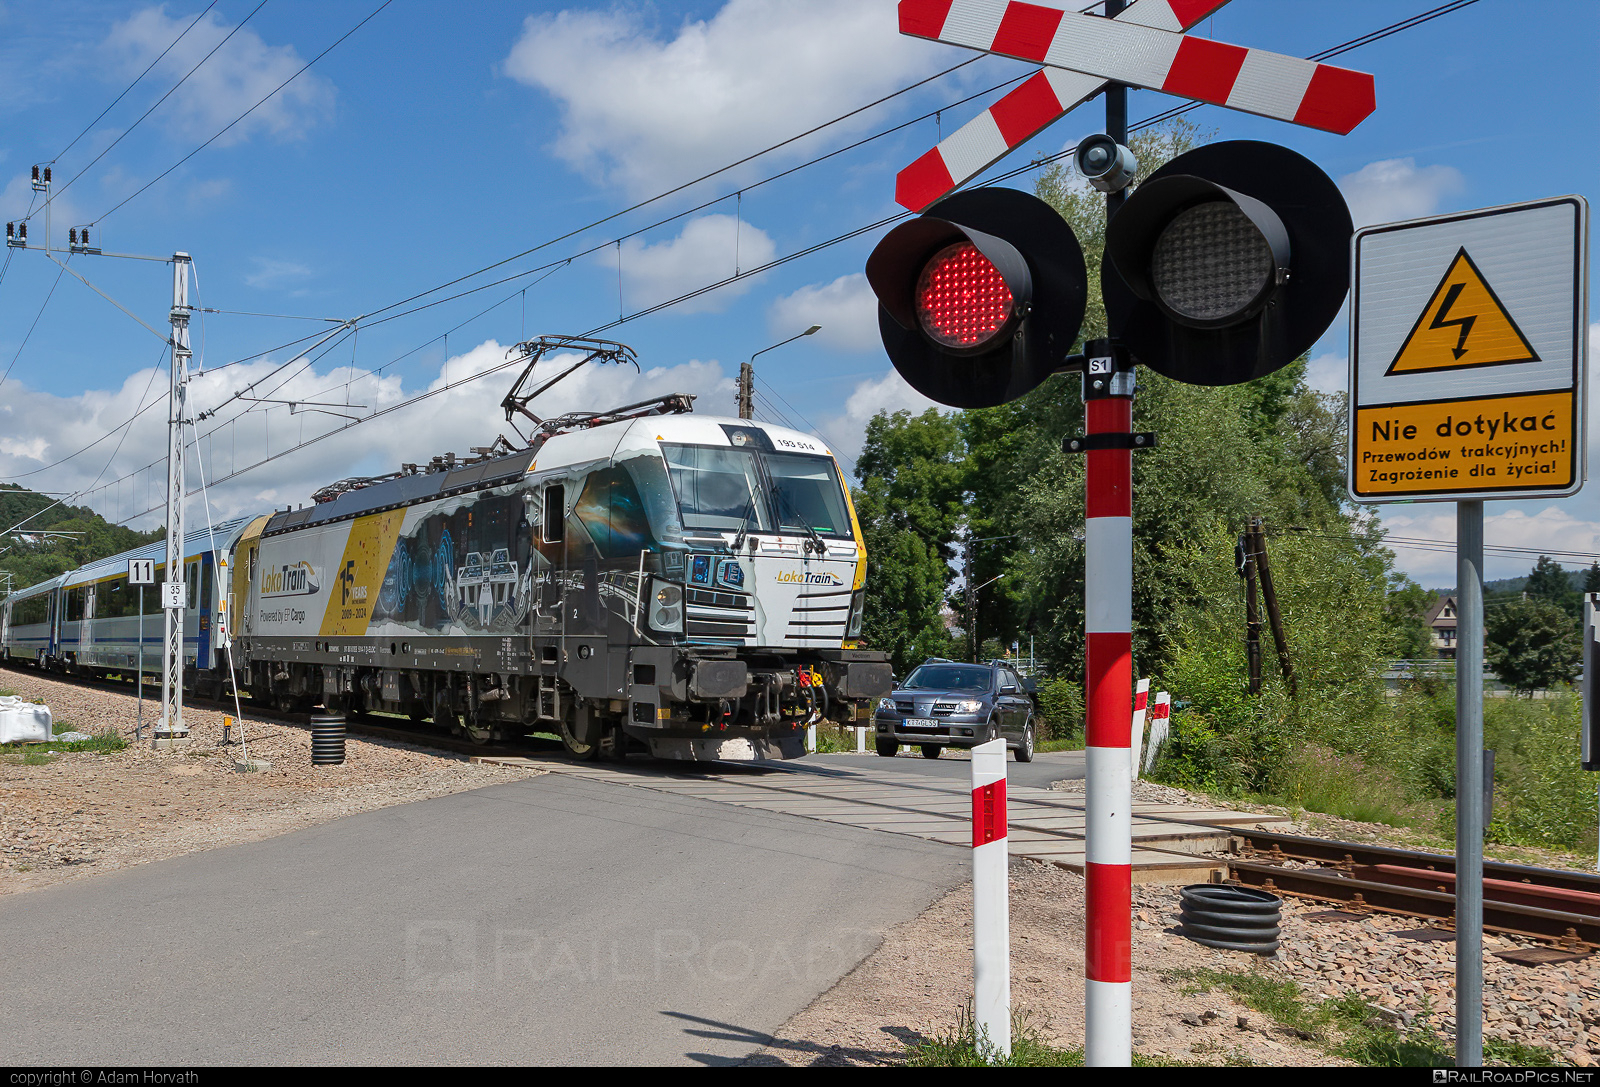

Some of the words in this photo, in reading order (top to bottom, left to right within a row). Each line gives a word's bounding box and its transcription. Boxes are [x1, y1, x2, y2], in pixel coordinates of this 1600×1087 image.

[1091, 359, 1107, 371] S1
[1372, 420, 1418, 442] Nie
[1436, 410, 1556, 440] dotykać
[777, 439, 796, 448] 193
[797, 441, 815, 451] 514
[1363, 447, 1450, 463] Przewodów
[1461, 439, 1565, 459] trakcyjnych!
[1370, 466, 1458, 484] Zagrożenie
[1469, 464, 1496, 477] dla
[1507, 460, 1556, 478] życia!
[133, 562, 150, 581] 11
[261, 561, 306, 593] LokoTrain
[777, 570, 832, 584] LokoTrain
[340, 560, 355, 606] 15
[170, 586, 181, 595] 35
[351, 586, 368, 599] YEARS
[172, 596, 178, 605] 5
[260, 609, 277, 622] Powered
[278, 609, 284, 624] by
[291, 608, 306, 624] Cargo
[341, 609, 352, 619] 2009
[356, 608, 367, 618] 2024
[573, 608, 578, 619] 2
